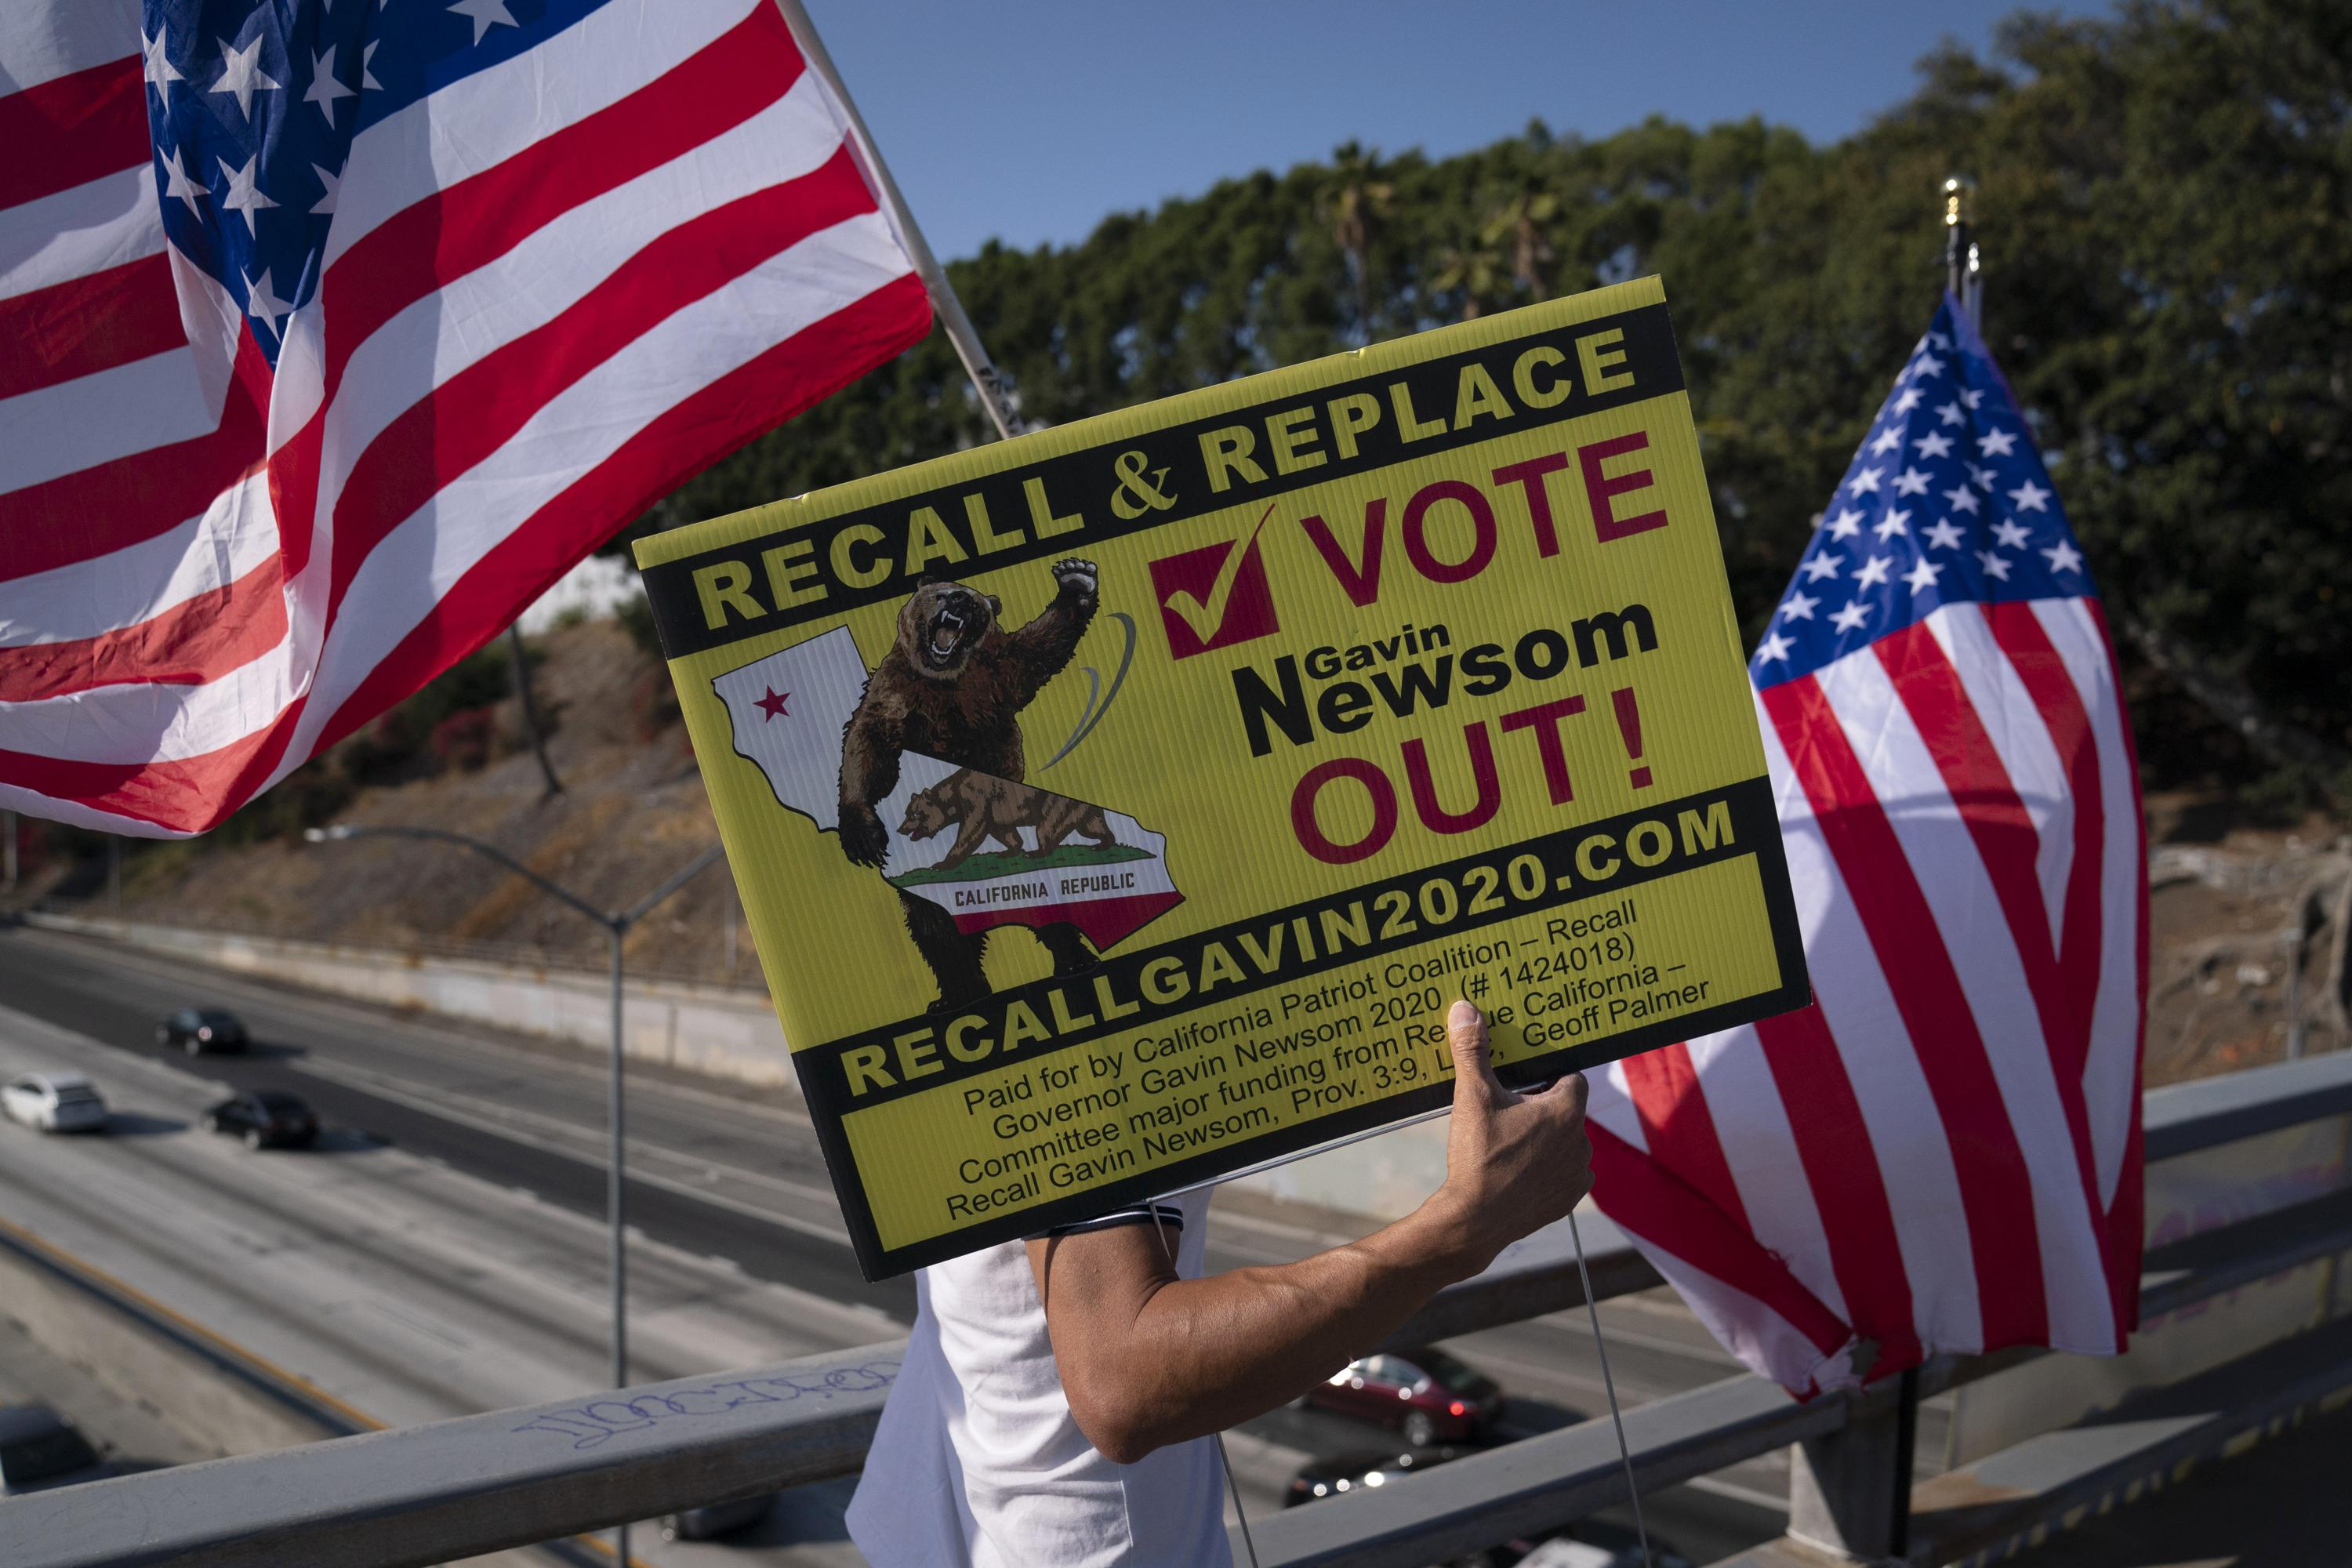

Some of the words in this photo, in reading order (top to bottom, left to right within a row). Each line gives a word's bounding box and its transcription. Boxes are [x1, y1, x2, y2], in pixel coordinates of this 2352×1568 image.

[692, 477, 1085, 630] RECALL
[1111, 450, 1178, 520] &
[1198, 327, 1636, 494] REPLACE
[1299, 430, 1669, 608] VOTE
[1231, 604, 1659, 758] Newsom
[1304, 624, 1450, 680] Gavin
[840, 800, 1736, 1097] RECALLGAVIN2020.COM
[955, 882, 1049, 906] CALIFORNIA
[1061, 873, 1135, 895] REPUBLIC
[946, 1172, 1040, 1220] Recall
[1049, 1149, 1135, 1188] Gavin
[1143, 1106, 1279, 1161] Newsom,
[1291, 1080, 1364, 1114] Prov.
[1374, 1057, 1428, 1089] 3:9,
[1523, 1005, 1599, 1047] Geoff
[1609, 981, 1709, 1025] Palmer
[959, 1123, 1120, 1184] Committee
[1129, 1093, 1210, 1134] major
[1218, 1058, 1326, 1105] funding
[1333, 1037, 1399, 1070] from
[1404, 1006, 1515, 1050] Ree
[1523, 964, 1660, 1016] California
[963, 1074, 1033, 1115] Paid
[1040, 1065, 1080, 1094] for
[1088, 1052, 1123, 1079] by
[1134, 1007, 1272, 1062] California
[1280, 973, 1377, 1019] Patriot
[1385, 940, 1511, 988] Coalition
[1546, 899, 1638, 945] Recall
[993, 1083, 1131, 1139] Governor
[1141, 1055, 1227, 1094] Gavin
[1234, 1015, 1362, 1067] Newsom
[1370, 987, 1442, 1028] 2020
